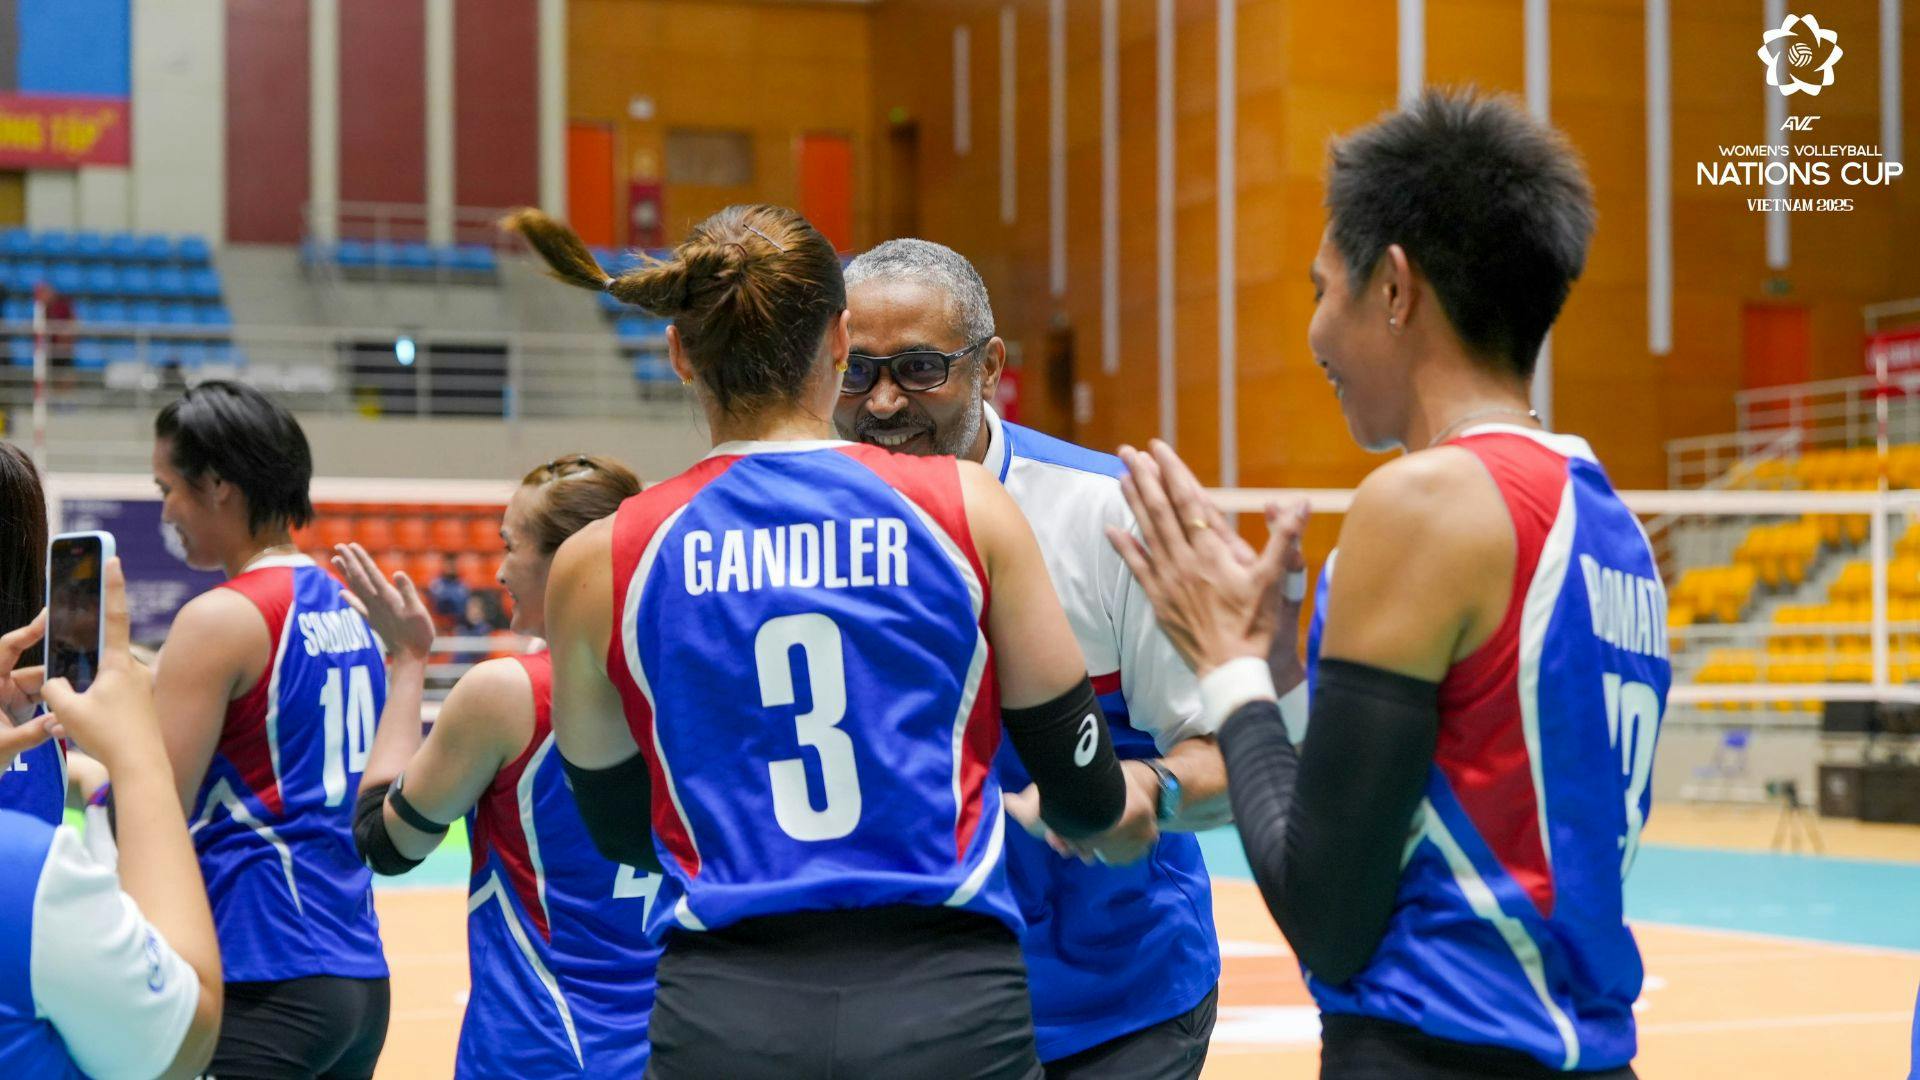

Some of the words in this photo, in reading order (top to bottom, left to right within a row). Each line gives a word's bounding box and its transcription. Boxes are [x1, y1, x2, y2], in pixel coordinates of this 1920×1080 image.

[683, 517, 909, 597] GANDLER
[319, 665, 376, 808] 14
[754, 612, 862, 842] 3
